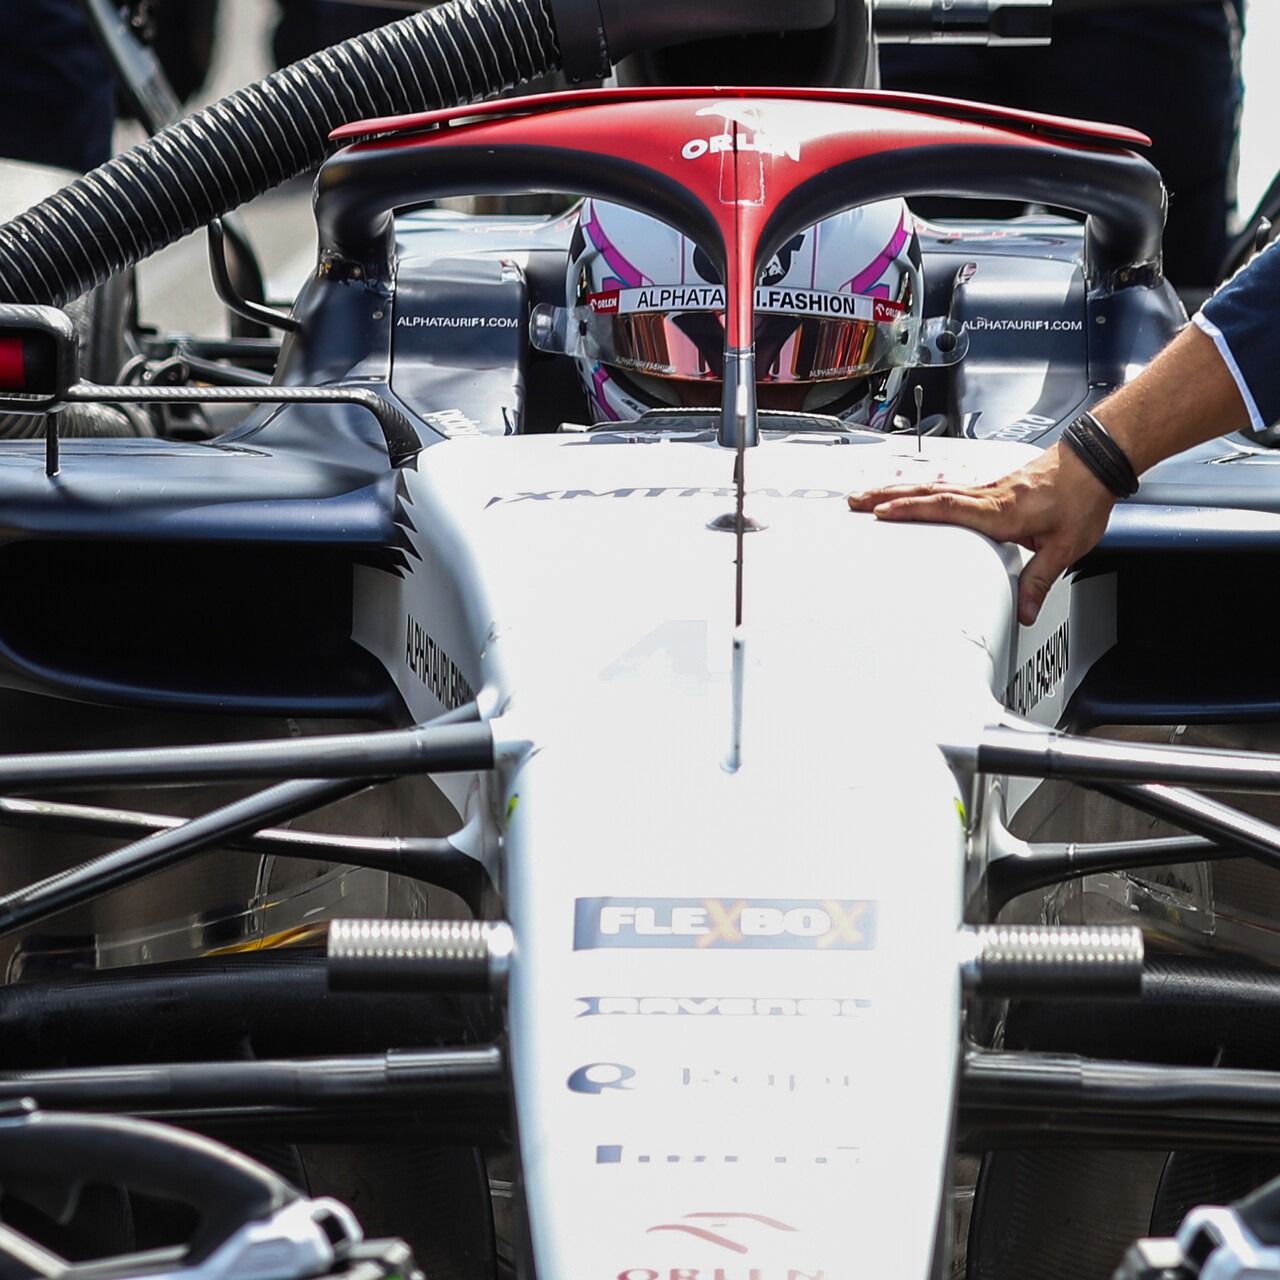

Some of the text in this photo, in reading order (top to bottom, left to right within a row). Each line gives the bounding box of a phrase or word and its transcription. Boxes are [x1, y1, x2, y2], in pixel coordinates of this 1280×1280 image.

[637, 289, 856, 315] ALPHATAI.FASHION
[396, 316, 519, 328] ALPHATAURIF1.COM
[962, 320, 1083, 331] ALPHATAURIF1.COM
[599, 899, 866, 949] FLEXBOX
